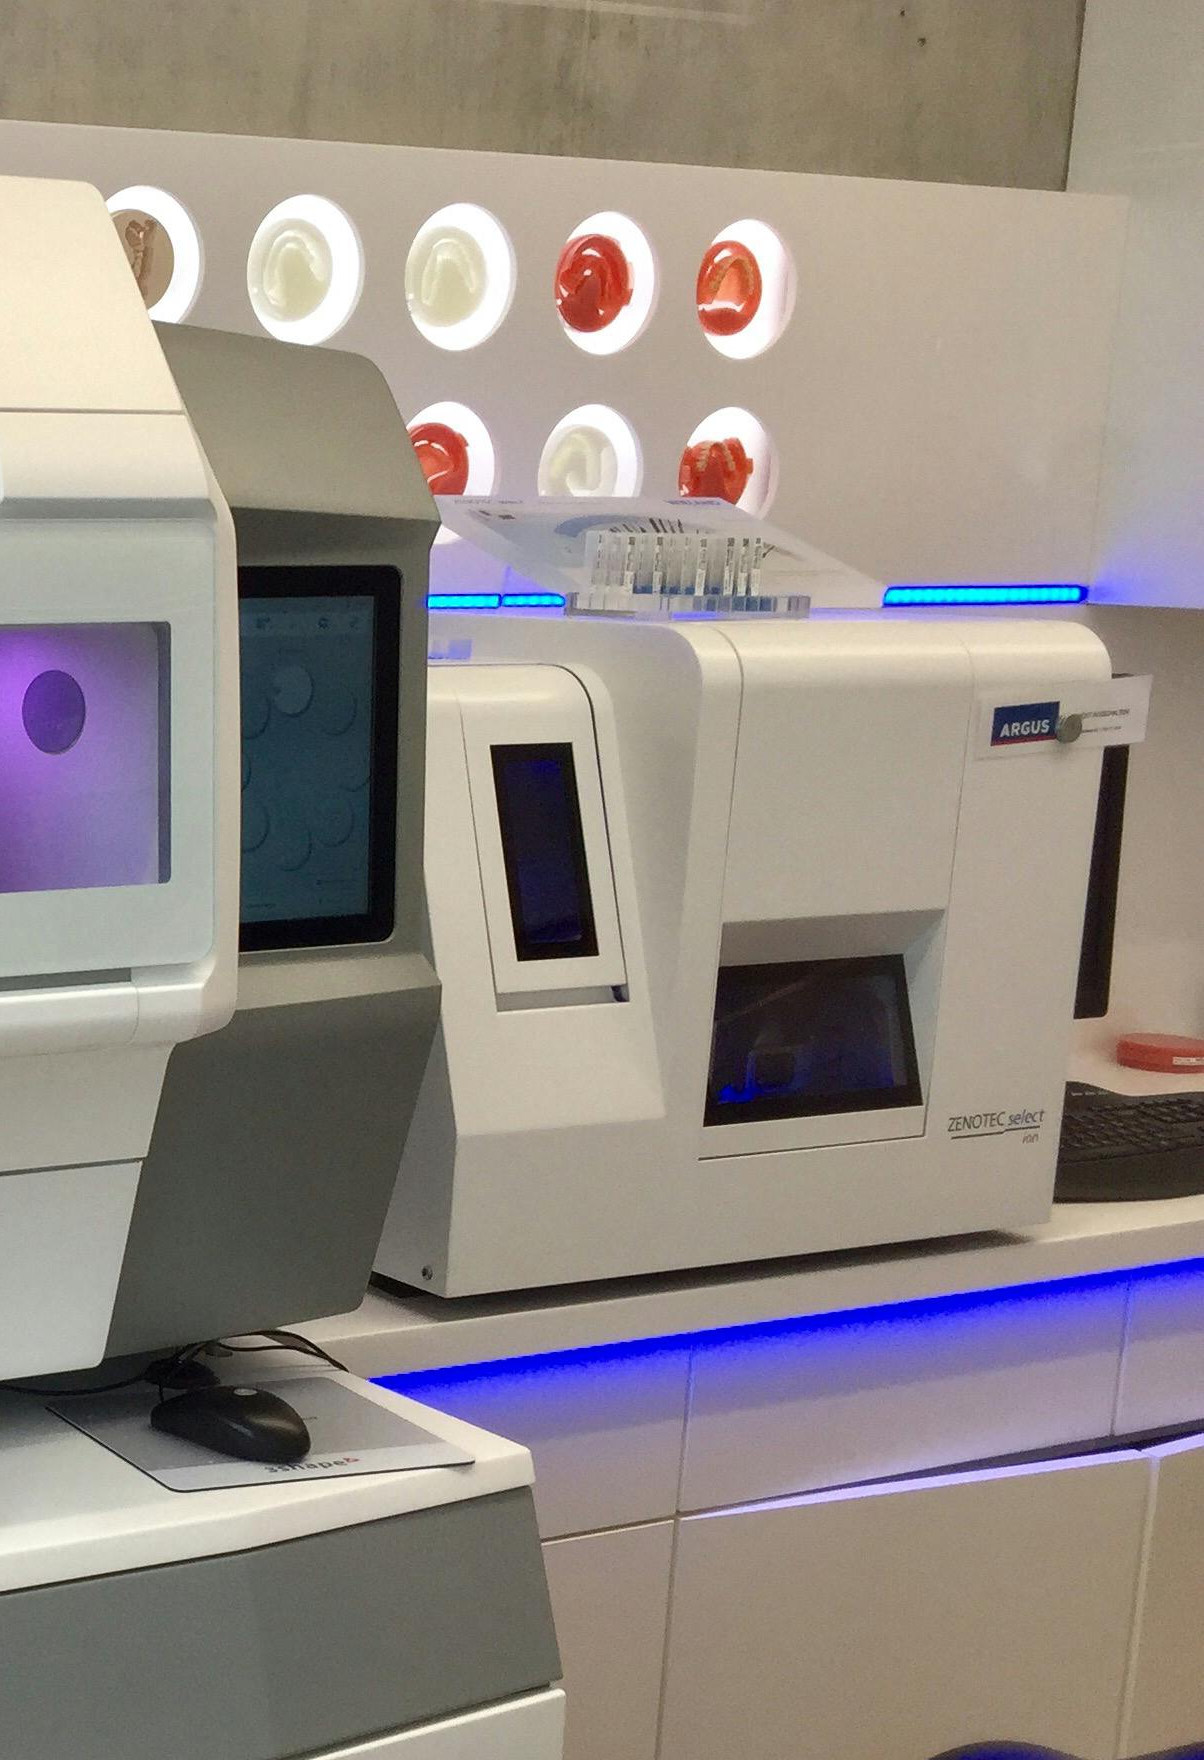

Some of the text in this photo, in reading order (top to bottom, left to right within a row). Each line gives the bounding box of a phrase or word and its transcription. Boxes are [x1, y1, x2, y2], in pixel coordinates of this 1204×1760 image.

[999, 719, 1050, 738] ARGUS
[947, 1109, 1045, 1132] ZENOTEC select
